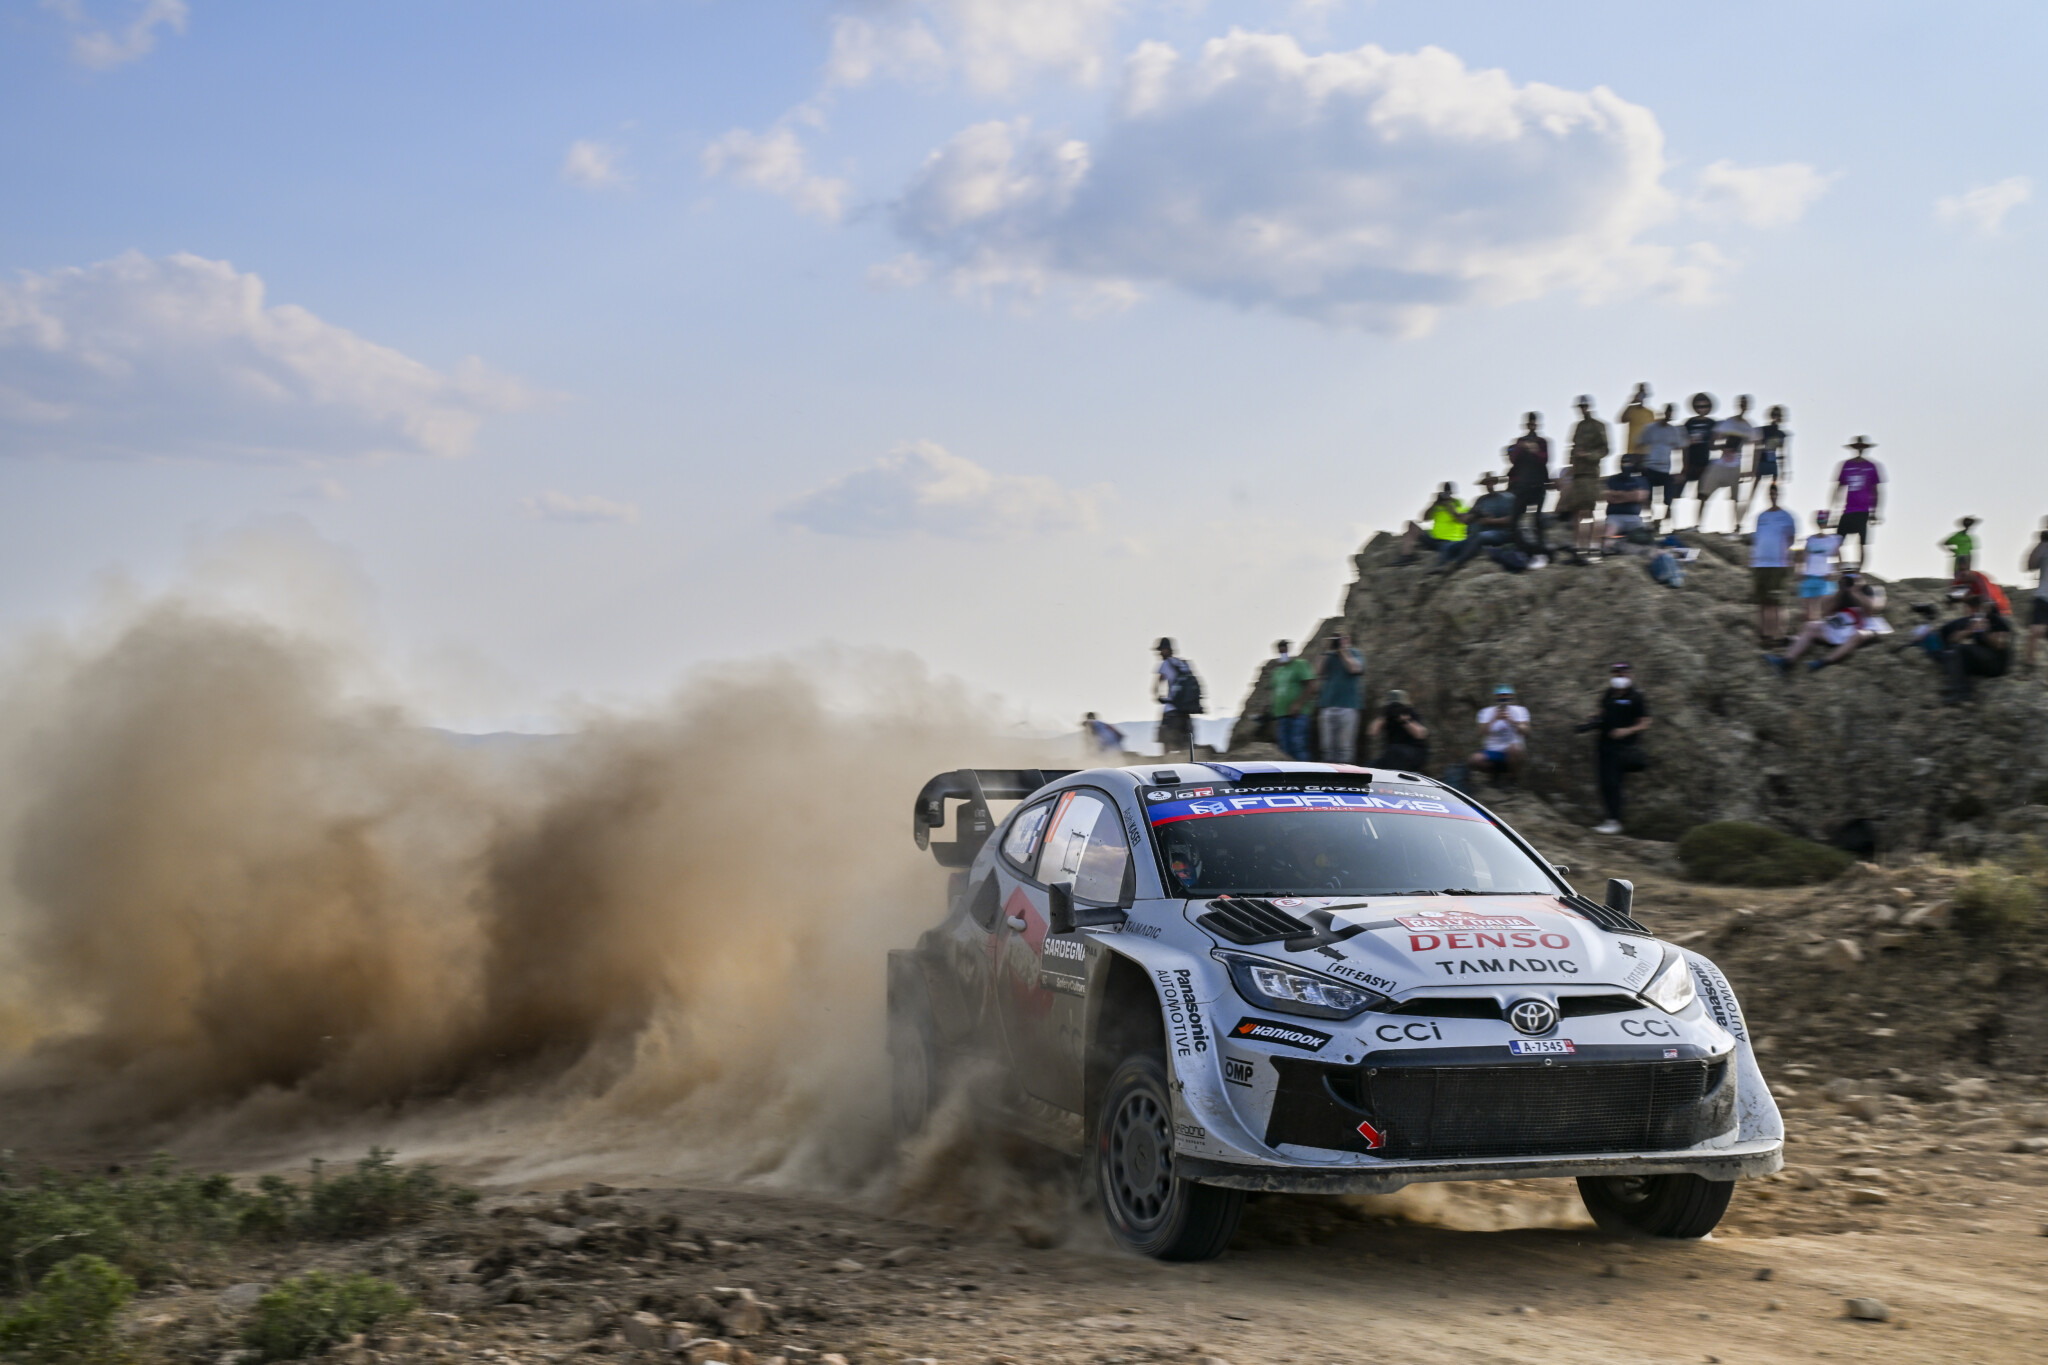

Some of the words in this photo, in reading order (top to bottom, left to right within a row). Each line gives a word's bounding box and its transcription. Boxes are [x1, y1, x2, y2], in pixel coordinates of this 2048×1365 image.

[1176, 788, 1213, 799] GR
[1220, 785, 1300, 794] TOYOTA
[1304, 785, 1374, 793] GAZOO
[1379, 787, 1442, 801] Racing
[1229, 795, 1450, 814] FORUM8
[1125, 921, 1162, 939] TAMADIC
[1409, 917, 1466, 928] RALLY
[1473, 916, 1527, 927] ITALIA
[1408, 932, 1571, 952] DENSO
[1435, 958, 1579, 975] TAMADIC
[1689, 961, 1729, 1028] anasonic
[1700, 961, 1746, 1042] AUTOMOTIVE
[1156, 969, 1191, 1057] AUTOMOTIVE
[1173, 968, 1210, 1053] Panasonic
[1524, 1041, 1564, 1053] A-7545
[1225, 1061, 1254, 1084] OMP
